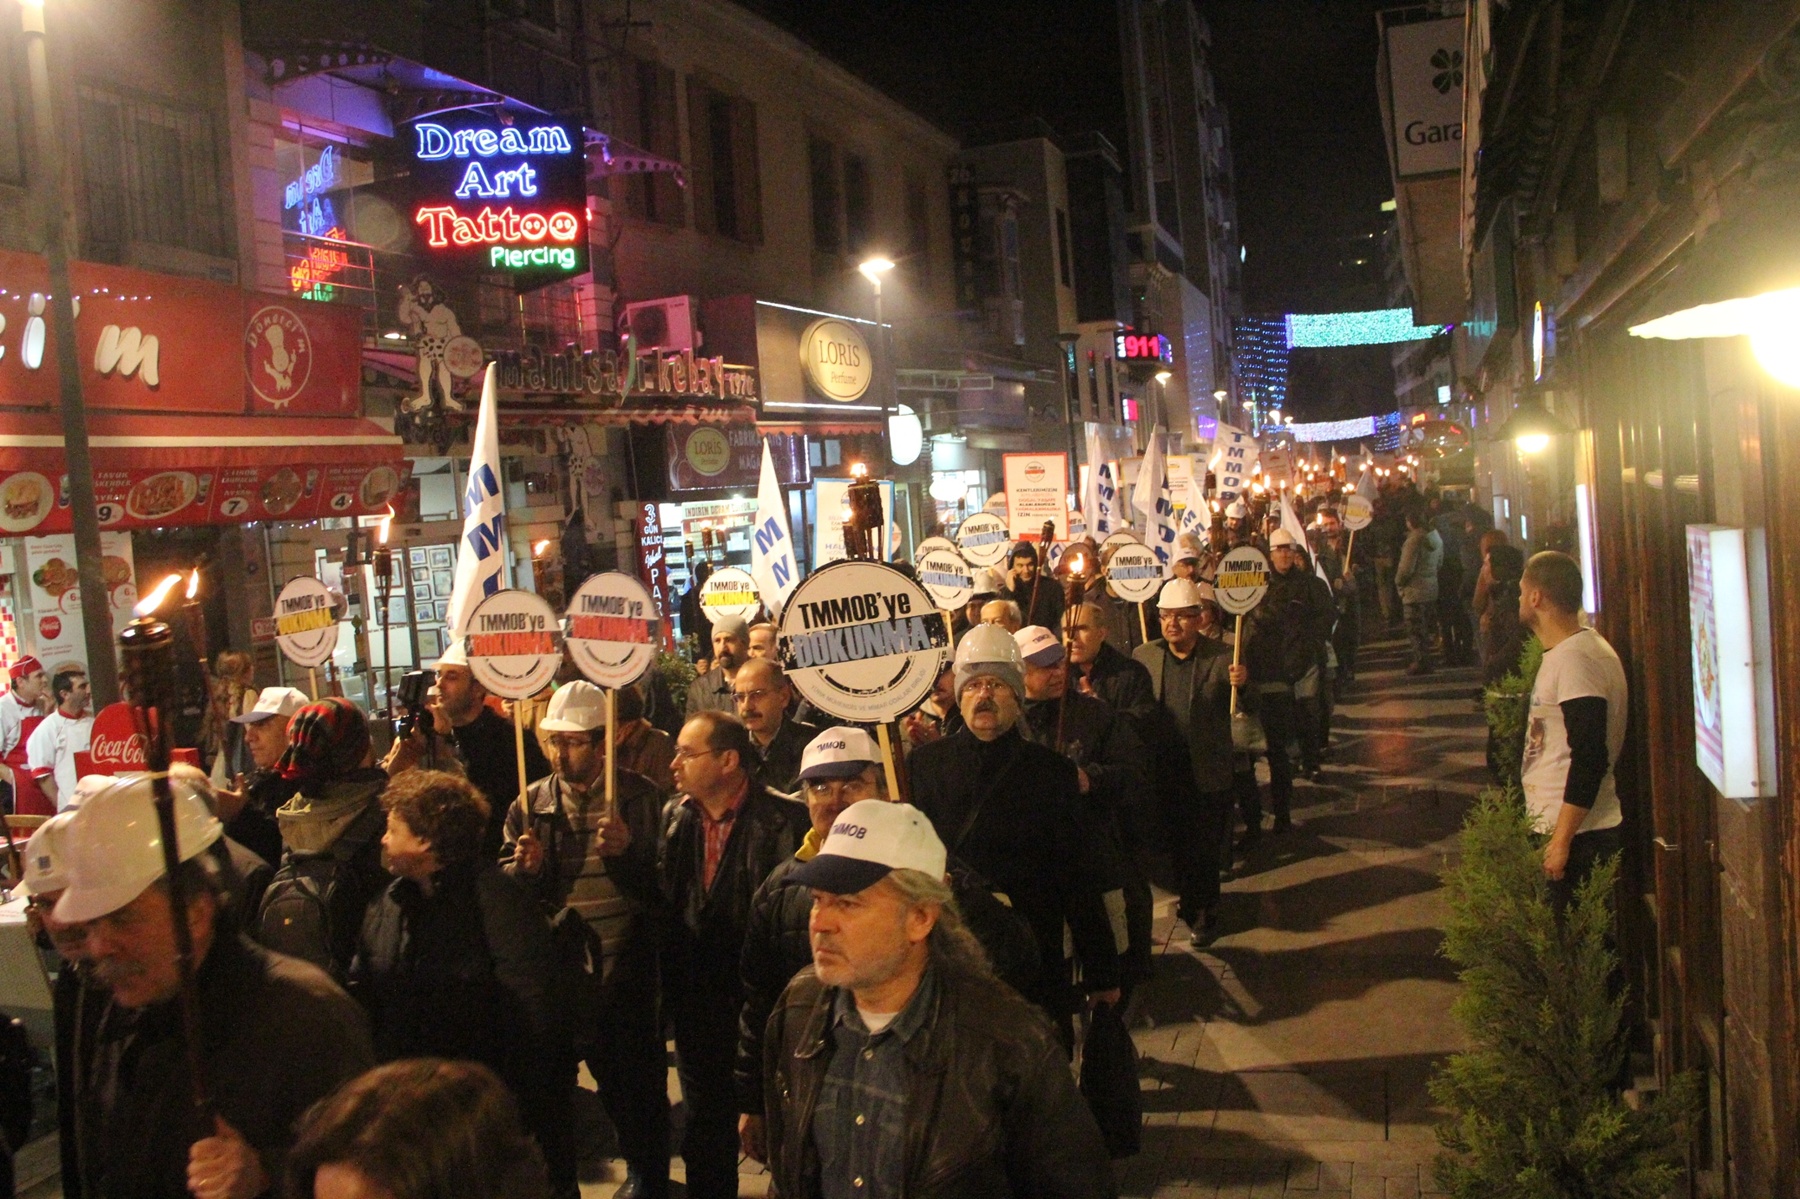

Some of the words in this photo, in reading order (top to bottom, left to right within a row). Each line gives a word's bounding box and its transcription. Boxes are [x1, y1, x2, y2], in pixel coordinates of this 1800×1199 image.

[415, 122, 572, 160] Dream
[455, 161, 537, 198] Art
[416, 205, 578, 247] Tattoo
[490, 246, 576, 269] Piercing
[818, 337, 861, 368] LORİS
[1125, 335, 1161, 358] 911
[1221, 431, 1246, 500] TMMOB
[94, 479, 132, 487] SKENDER
[228, 500, 241, 515] 7
[334, 495, 347, 509] 4
[99, 505, 112, 521] 9
[964, 523, 1000, 536] TMMOB'ye
[926, 560, 964, 575] TMMOB'ye
[1114, 556, 1153, 567] TMMOB'ye
[1224, 560, 1263, 576] TMMOB'ye
[709, 580, 750, 593] TMMOB'ye
[581, 594, 643, 619] TMMOB'ye
[798, 591, 912, 630] TMMOB'ye
[479, 612, 545, 632] TMMOB'ye
[792, 616, 932, 669] DOKUNMA
